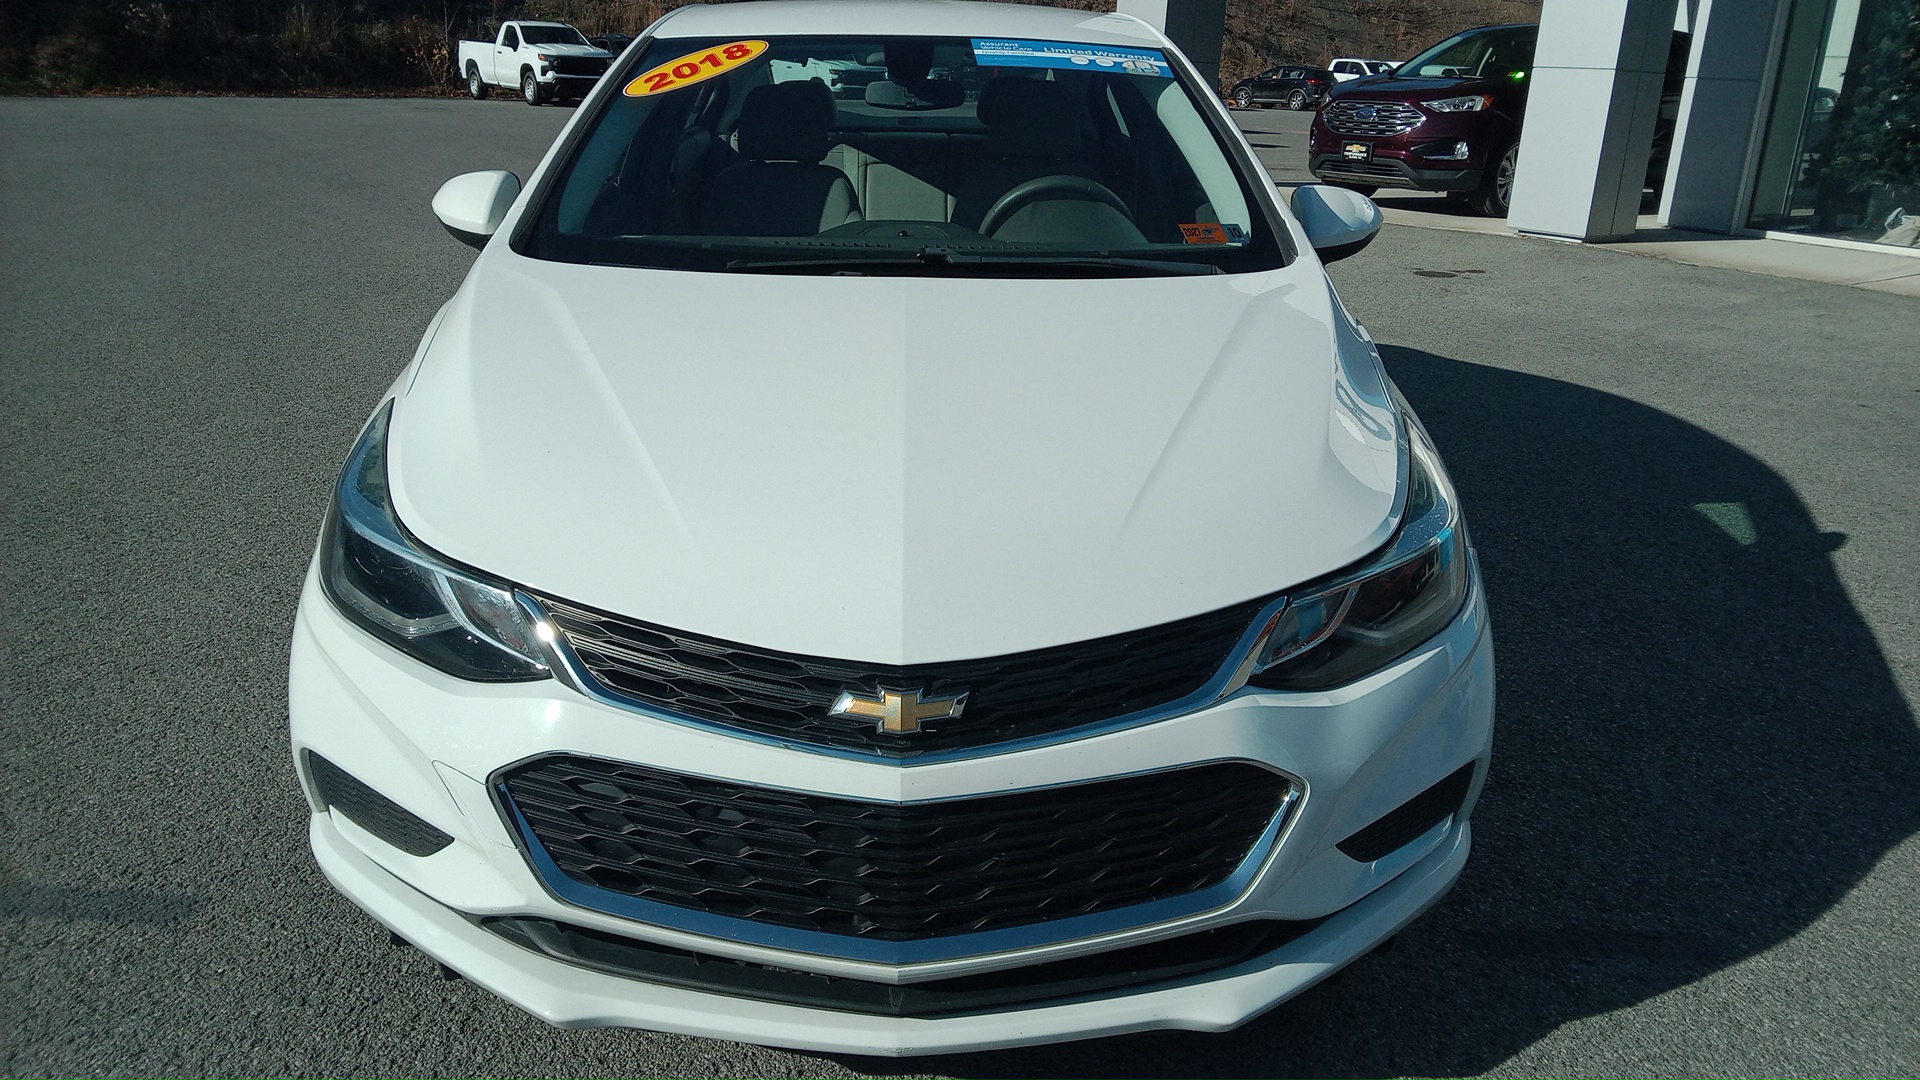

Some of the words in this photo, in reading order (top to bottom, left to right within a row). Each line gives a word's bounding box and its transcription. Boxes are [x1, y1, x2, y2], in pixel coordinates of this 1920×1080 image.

[1043, 47, 1092, 55] Limited
[1094, 51, 1155, 61] Warranty
[643, 44, 753, 92] 2018
[1227, 227, 1242, 238] 10
